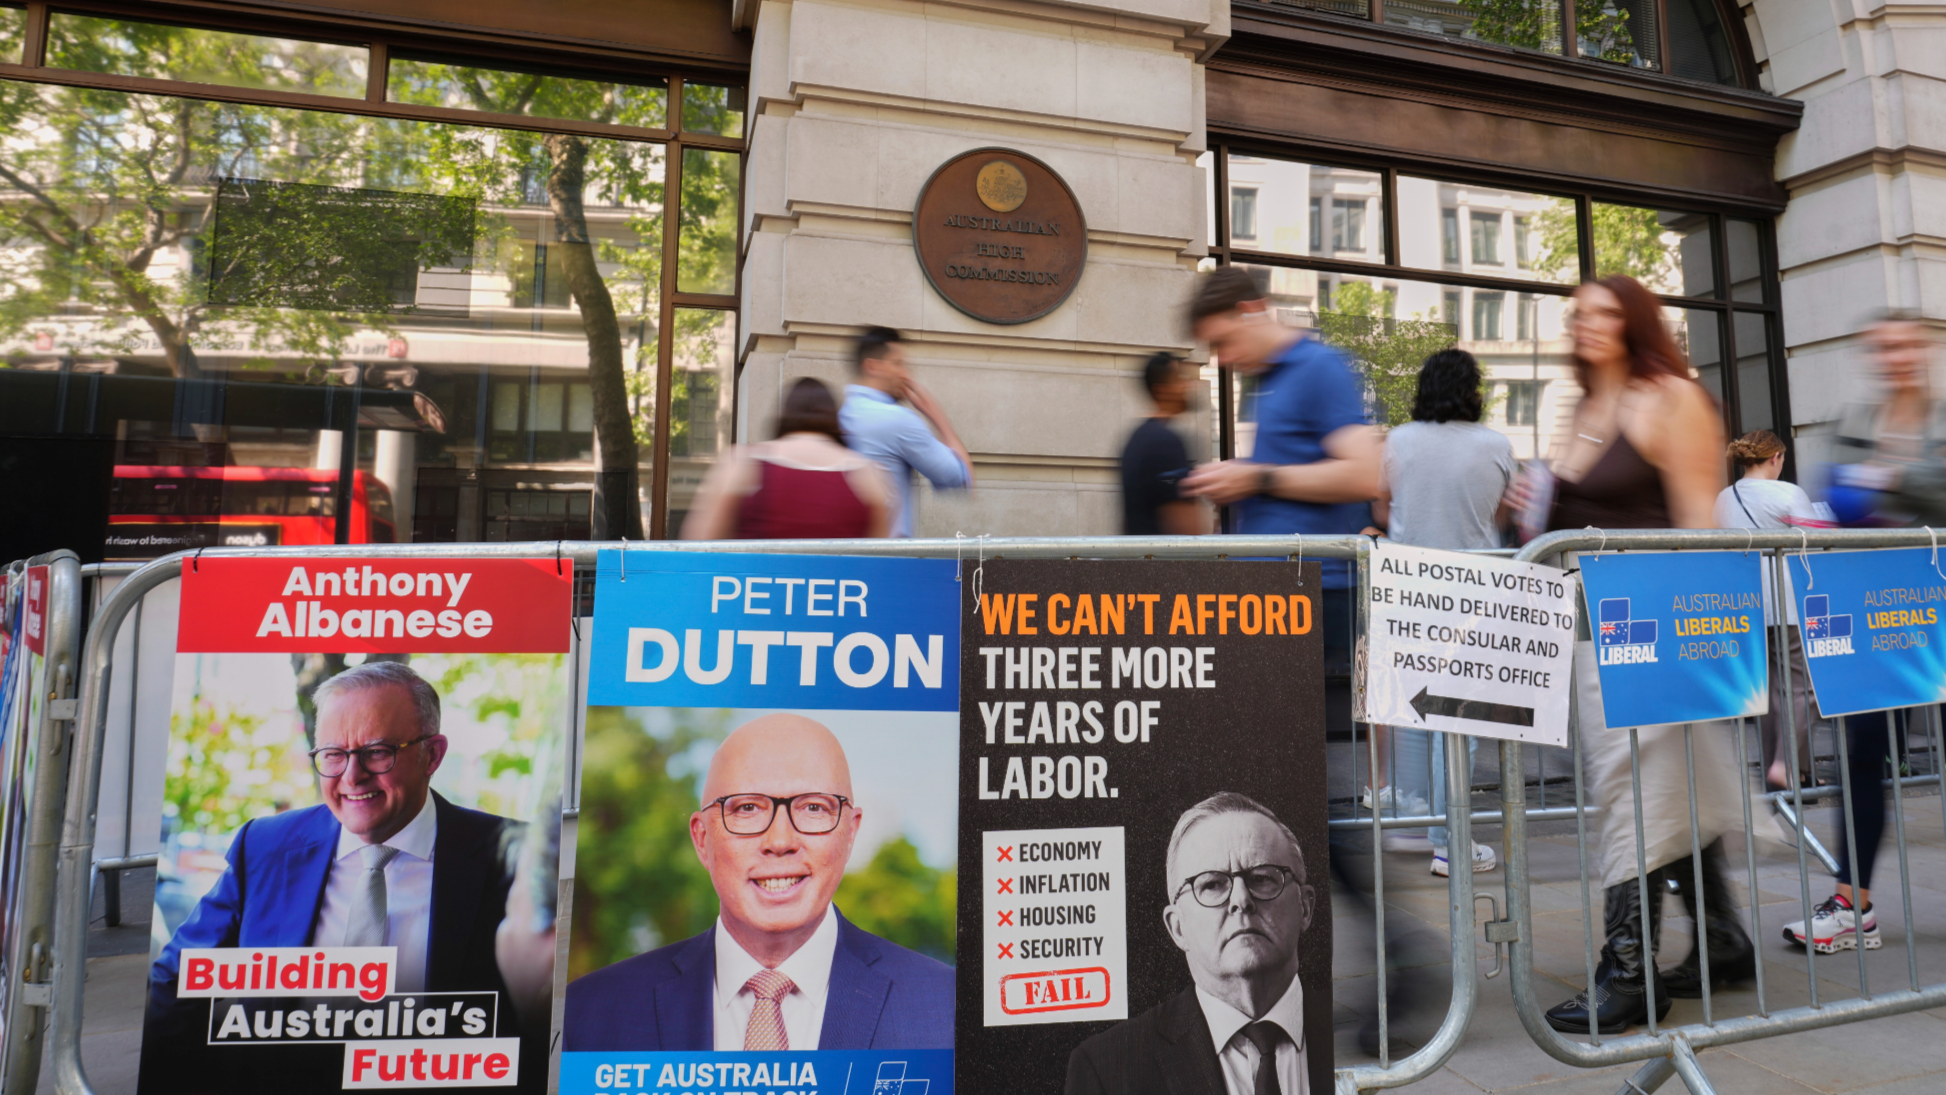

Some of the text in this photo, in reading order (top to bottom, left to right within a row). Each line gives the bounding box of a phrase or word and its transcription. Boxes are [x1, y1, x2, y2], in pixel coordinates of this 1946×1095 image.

[944, 214, 1060, 236] AUSTRALIAN
[977, 243, 1025, 260] HIGH
[945, 264, 1060, 285] COMMISSION
[281, 565, 473, 607] Anthony
[1380, 557, 1565, 599] ALL POSTAL VOTES TO
[711, 575, 868, 617] PETER
[1371, 586, 1573, 631] BE HAND DELIVERED TO
[1672, 592, 1761, 613] AUSTRALIAN
[1864, 586, 1946, 607] AUSTRALIAN
[255, 601, 493, 638] Albanese
[980, 593, 1313, 635] WE CAN'T AFFORD
[1675, 615, 1750, 637] LIBERALS
[1866, 608, 1938, 629] LIBERALS
[1386, 618, 1560, 659] THE CONSULAR AND
[1678, 640, 1740, 661] ABROAD
[1807, 638, 1855, 658] LIBERAL
[1872, 631, 1929, 652] ABROAD
[625, 627, 944, 689] DUTTON
[978, 646, 1216, 689] THREE MORE
[1600, 644, 1658, 666] LIBERAL
[1393, 651, 1551, 689] PASSPORTS OFFICE
[978, 700, 1161, 744] YEARS OF
[978, 755, 1119, 800] LABOR.
[1019, 841, 1102, 862] ECONOMY
[1019, 872, 1110, 894] INFLATION
[1019, 904, 1096, 927] HOUSING
[1020, 936, 1104, 959] SECURITY
[185, 952, 388, 1001] Building
[1024, 977, 1091, 1005] FAIL
[216, 997, 487, 1039] Australia's
[351, 1049, 510, 1082] Future
[595, 1061, 818, 1088] GET AUSTRALIA
